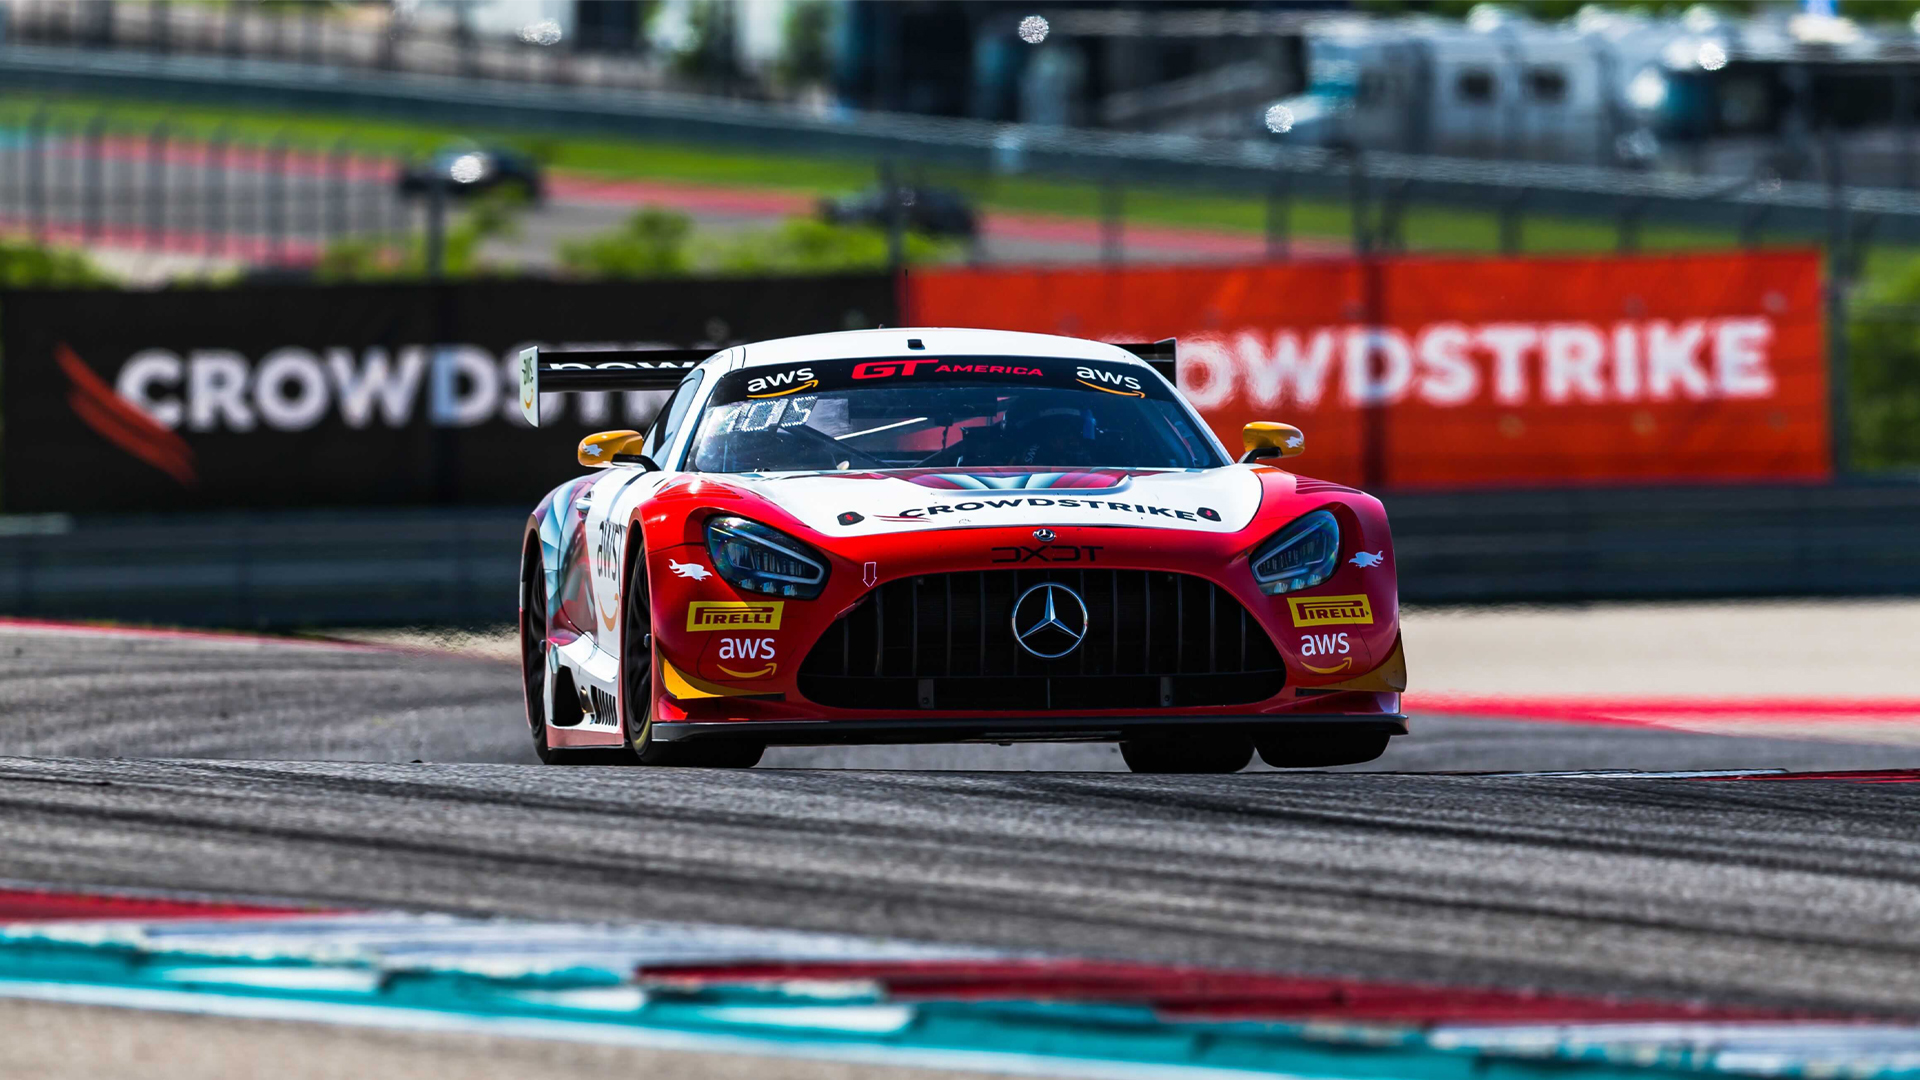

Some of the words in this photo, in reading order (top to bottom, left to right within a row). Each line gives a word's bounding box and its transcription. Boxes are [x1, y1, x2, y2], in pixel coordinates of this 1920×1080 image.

[747, 367, 815, 392] aws
[851, 359, 939, 379] GT
[934, 364, 1044, 376] AMERICA
[1076, 366, 1142, 390] aws
[899, 498, 1198, 522] CROWDSTRIKE
[694, 607, 775, 625] PIRELLI
[1295, 600, 1366, 620] PIRELLI
[718, 637, 776, 660] aws
[1300, 632, 1350, 656] aws
